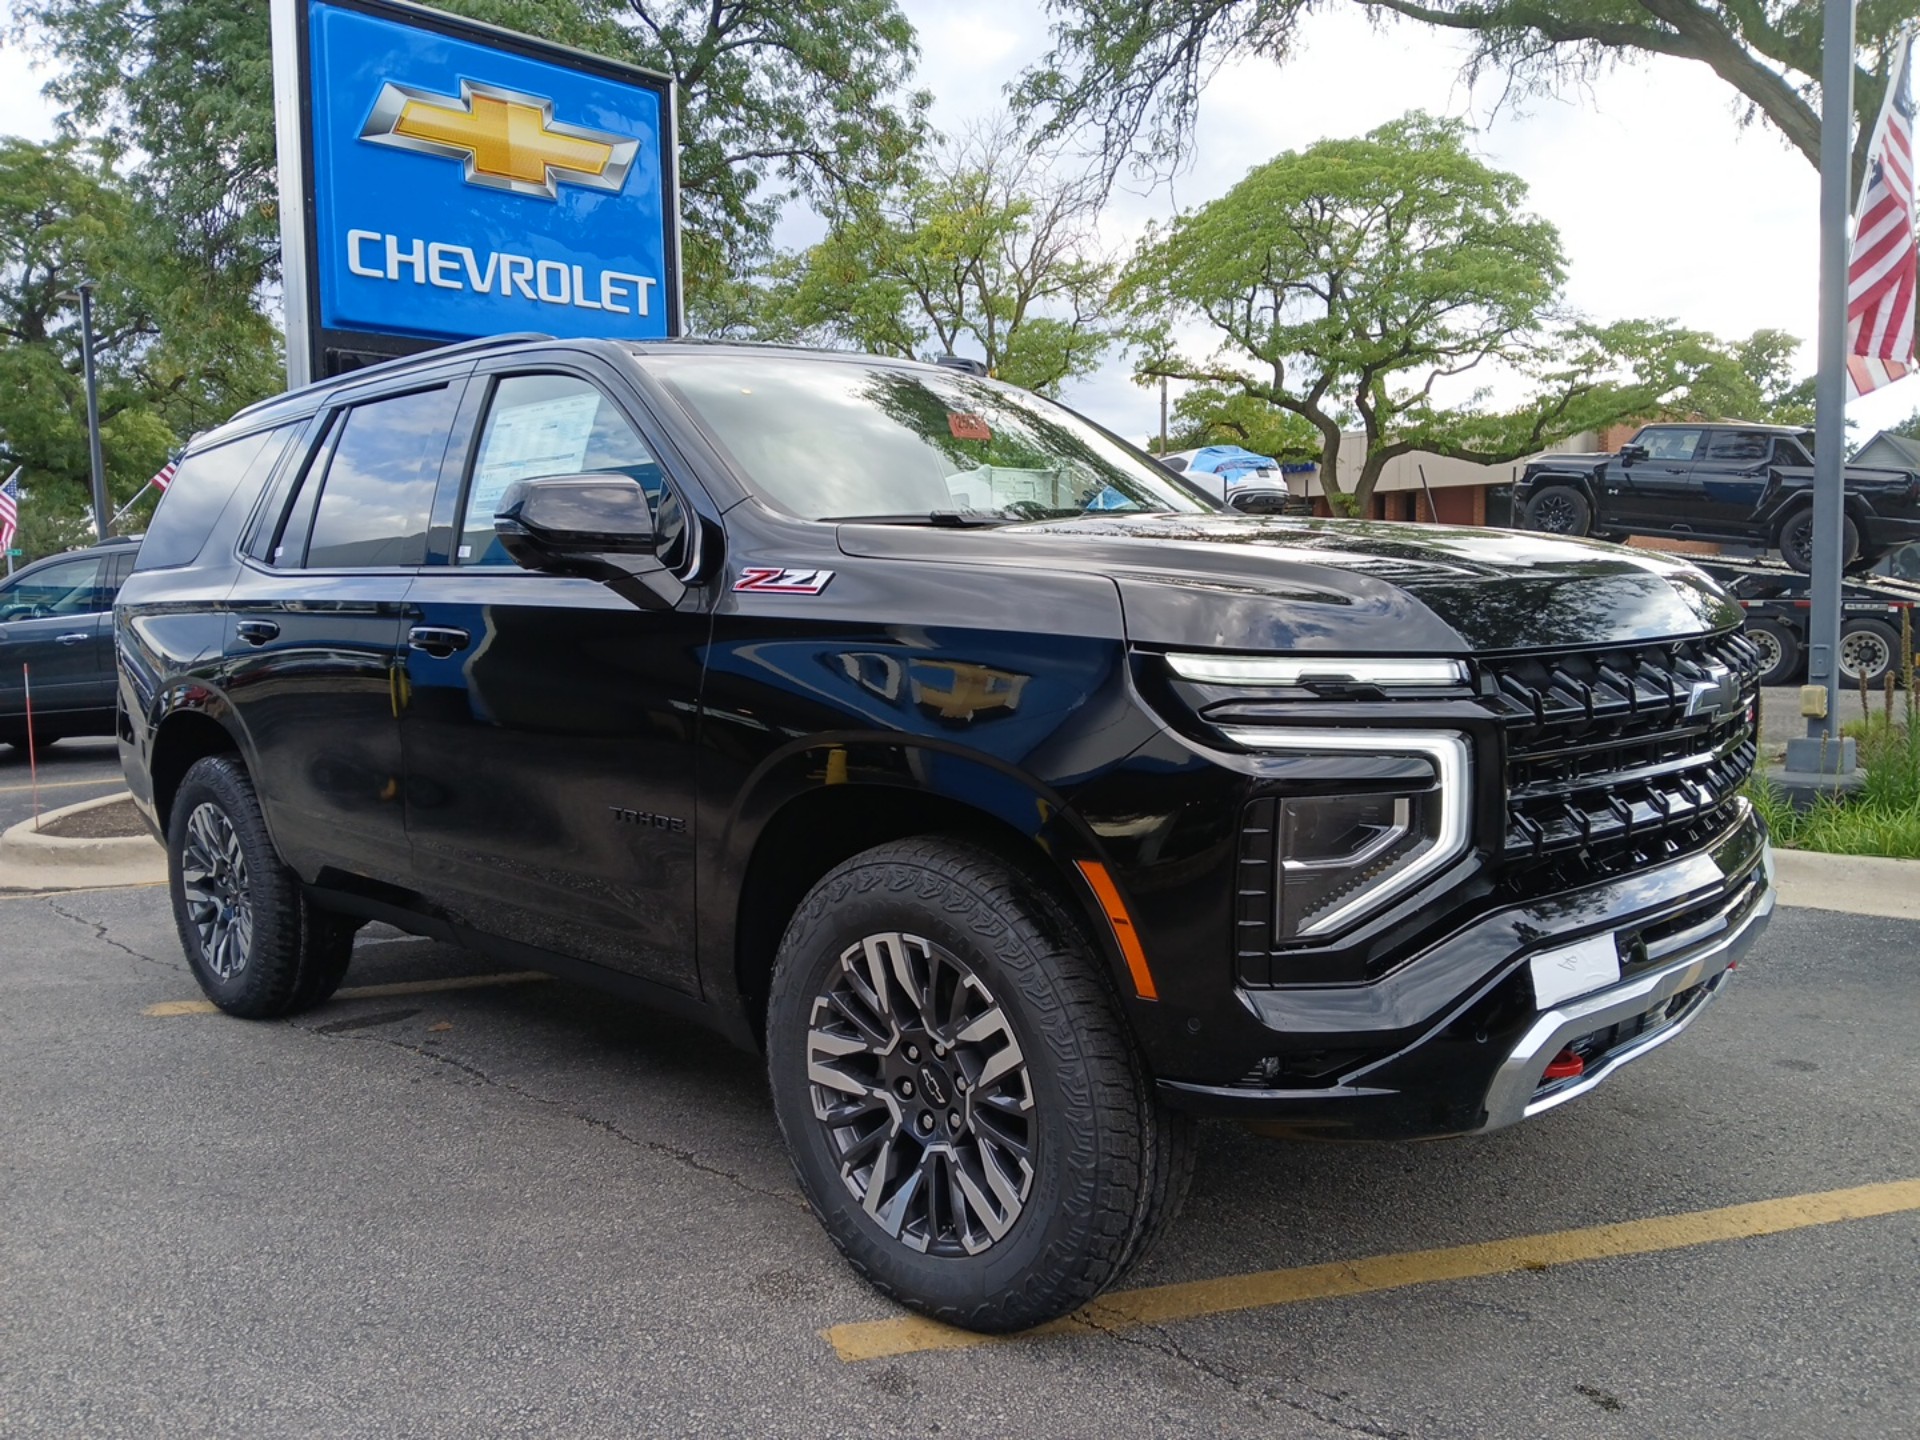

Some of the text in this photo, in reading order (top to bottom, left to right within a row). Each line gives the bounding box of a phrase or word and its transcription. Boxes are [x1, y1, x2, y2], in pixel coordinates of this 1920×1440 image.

[346, 228, 657, 316] CHEVROLET
[732, 567, 835, 596] Z71
[608, 805, 688, 833] TAHOE
